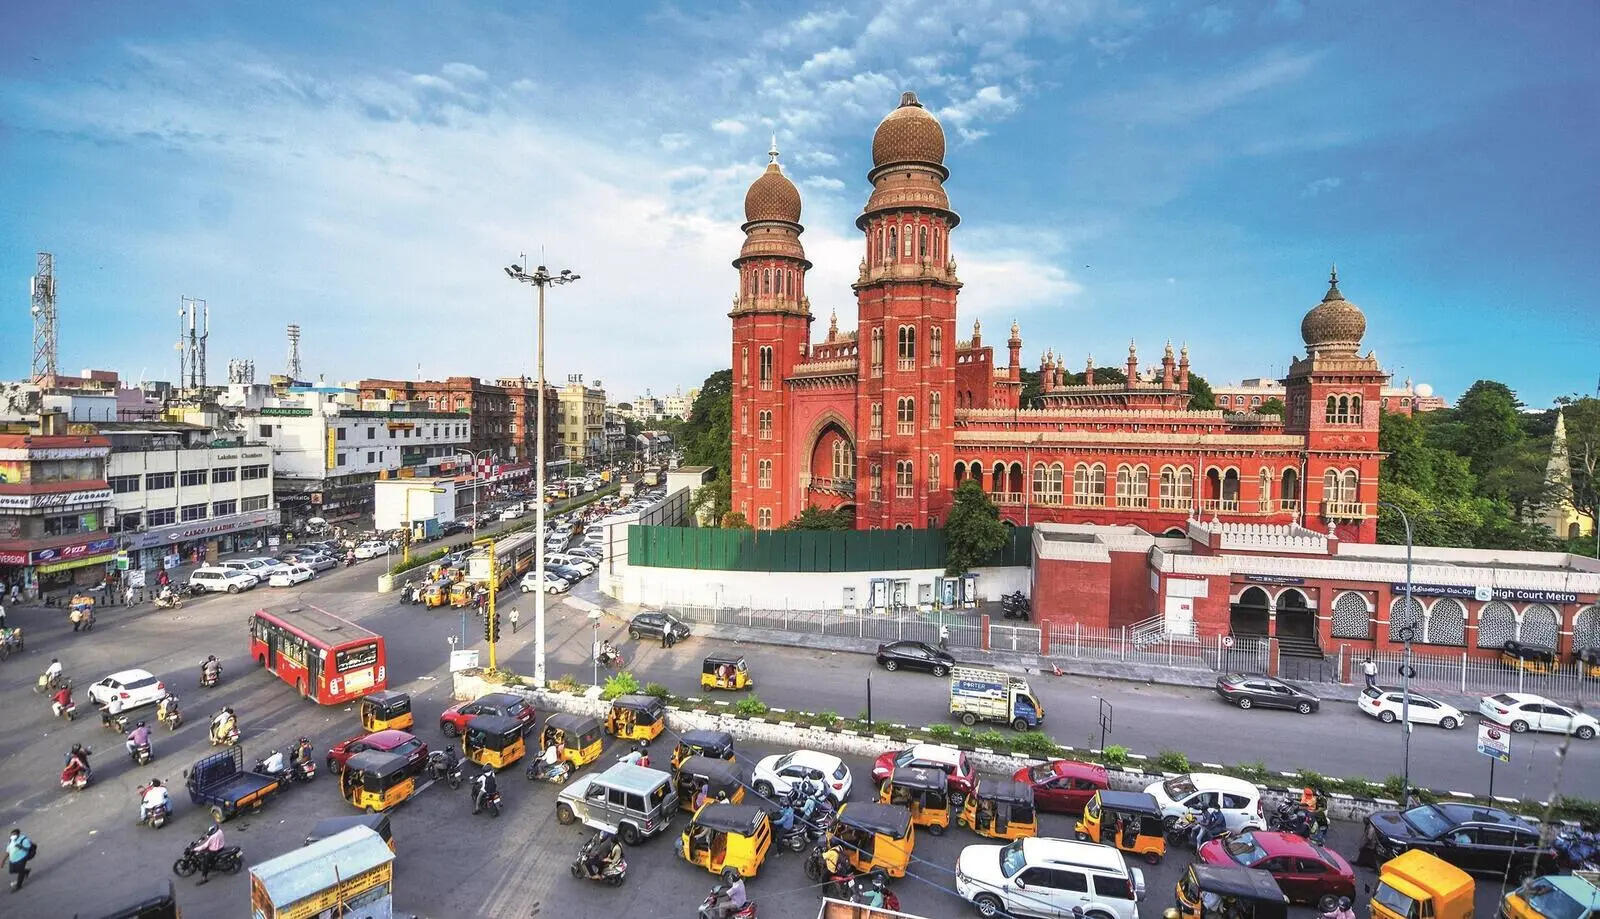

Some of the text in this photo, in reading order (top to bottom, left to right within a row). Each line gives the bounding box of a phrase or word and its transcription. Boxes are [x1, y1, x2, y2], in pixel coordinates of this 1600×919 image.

[496, 379, 517, 388] YMCA
[73, 491, 110, 501] LUGGAGE
[1396, 585, 1446, 594] உயநீதிமன்றம்
[1491, 589, 1576, 602] High Court Metro
